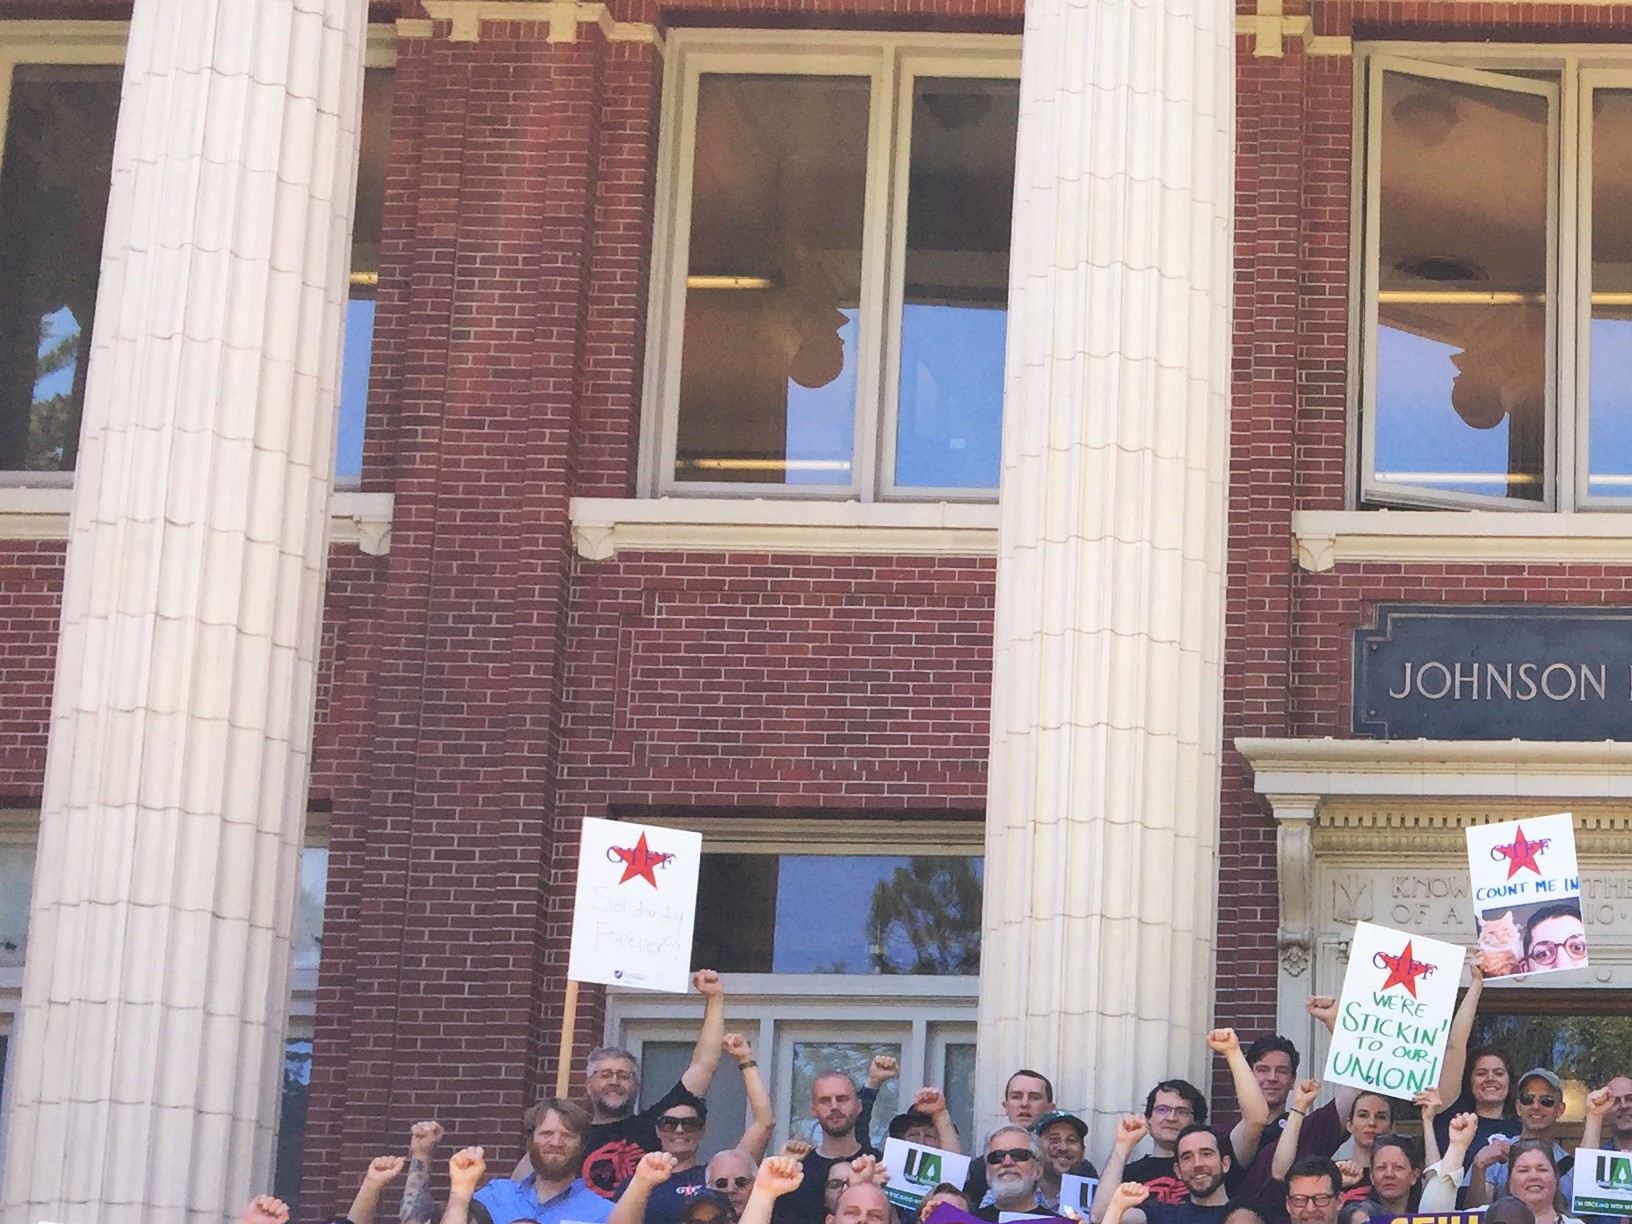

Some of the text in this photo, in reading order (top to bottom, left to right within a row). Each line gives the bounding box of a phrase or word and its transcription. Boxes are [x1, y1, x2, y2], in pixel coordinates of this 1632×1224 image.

[1389, 661, 1606, 701] JOHNSON
[1391, 876, 1473, 900] KNOW
[1476, 875, 1580, 902] COUNT ME IN
[1391, 903, 1431, 926] OF
[1441, 906, 1465, 926] A
[1372, 951, 1439, 981] GTFF
[1372, 990, 1430, 1019] WE'RE
[1341, 1001, 1449, 1047] STICKIN'
[1356, 1036, 1433, 1065] TO OUR
